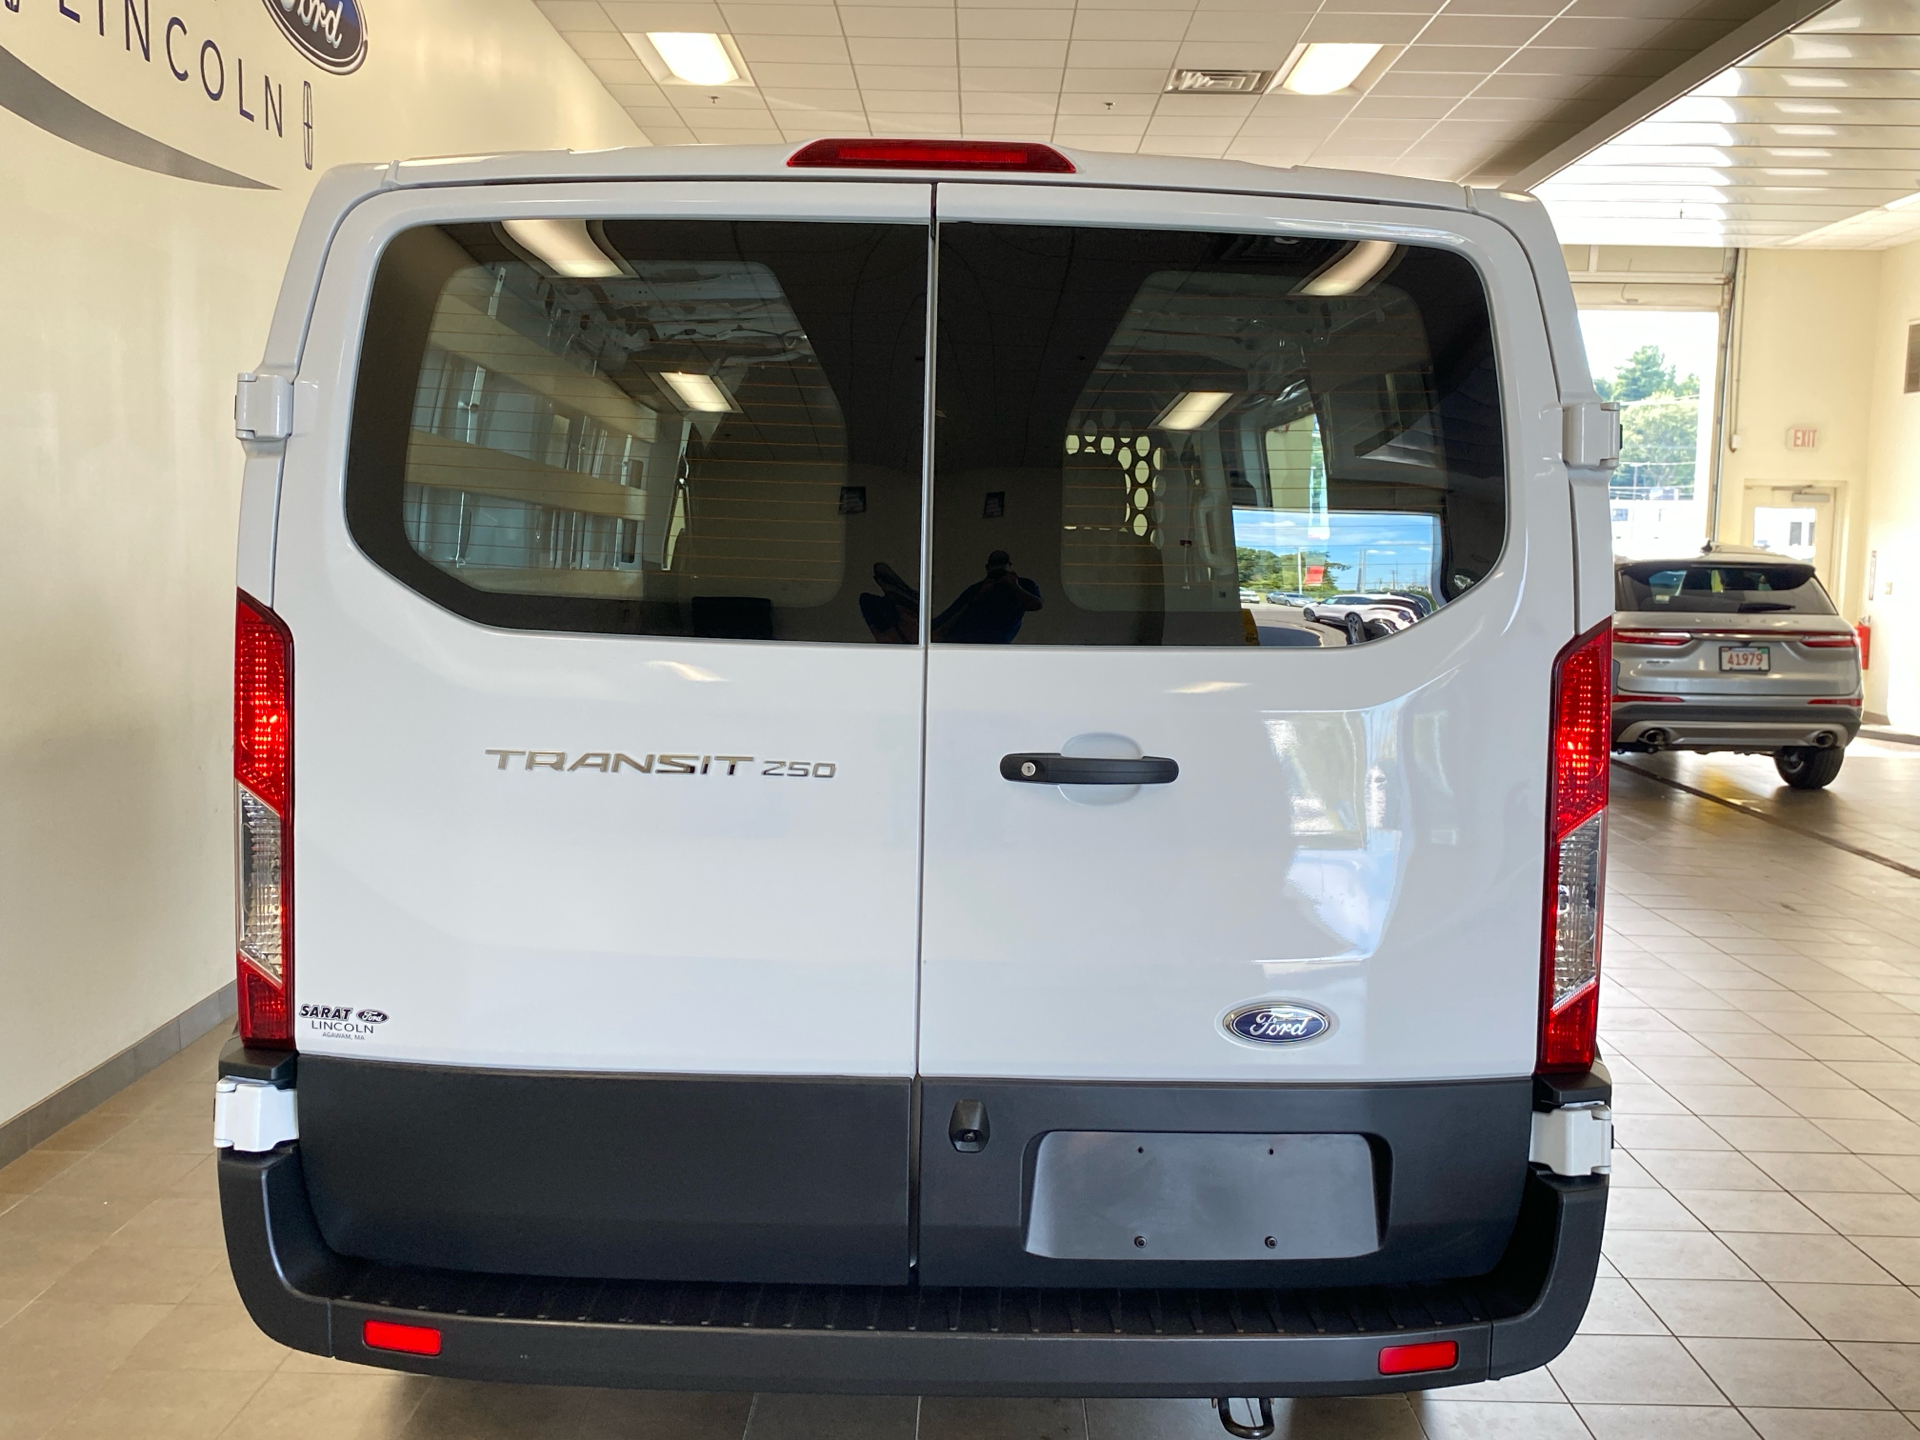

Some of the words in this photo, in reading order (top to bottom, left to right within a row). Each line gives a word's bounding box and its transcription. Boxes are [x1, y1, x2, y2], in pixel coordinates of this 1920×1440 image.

[281, 0, 343, 48] ord
[59, 0, 283, 137] INCOLN
[1793, 429, 1817, 448] EXIT
[1727, 653, 1763, 666] 41979
[485, 749, 754, 776] TRANSIT
[761, 760, 836, 778] 250
[300, 1004, 353, 1021] SARAT
[361, 1011, 384, 1022] Ford
[1249, 1012, 1309, 1035] Ford
[311, 1020, 374, 1034] LINCOLN
